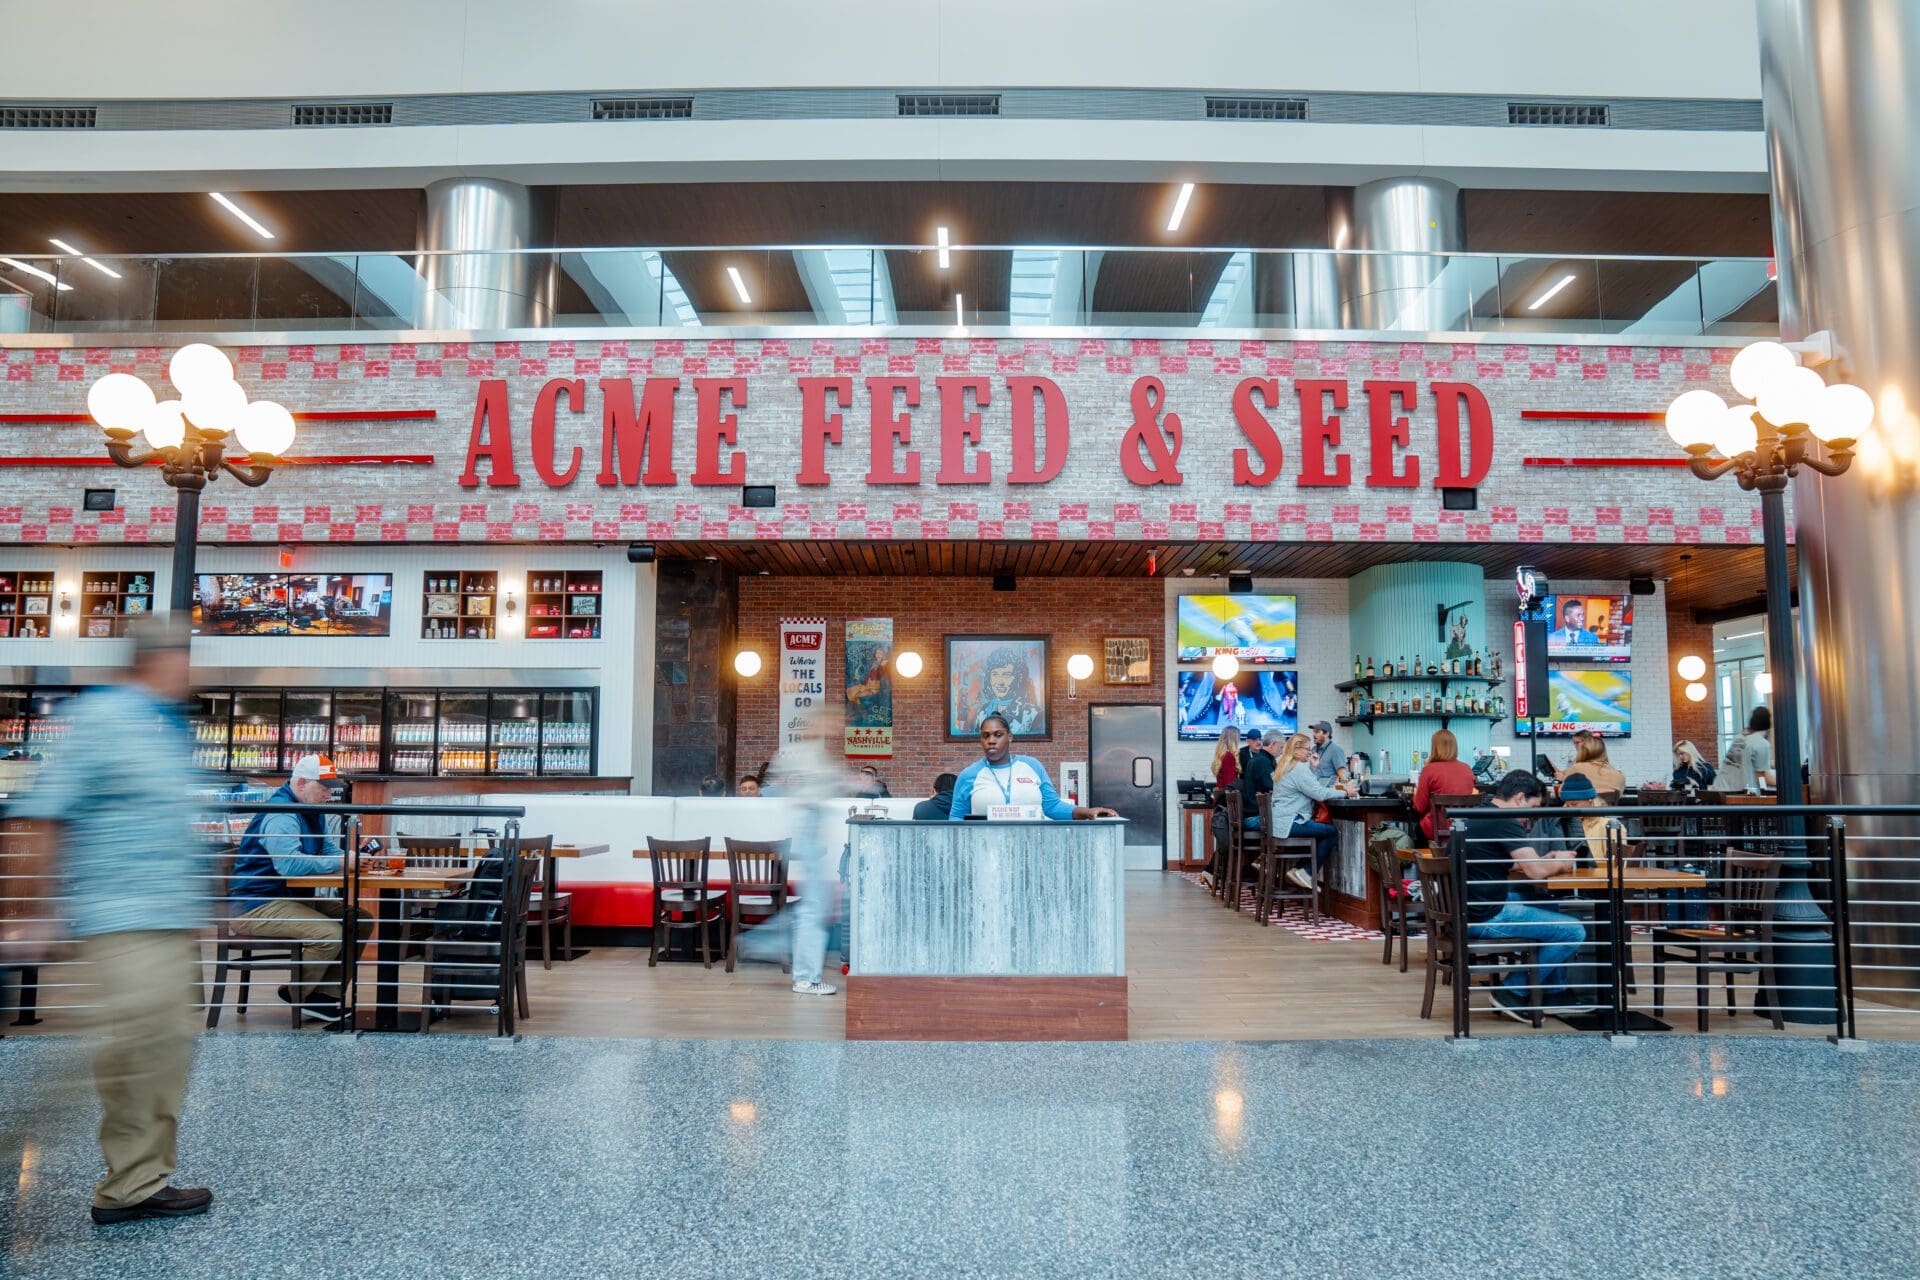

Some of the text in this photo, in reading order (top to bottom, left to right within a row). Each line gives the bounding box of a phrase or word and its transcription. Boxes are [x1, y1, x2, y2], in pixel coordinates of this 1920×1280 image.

[458, 375, 1494, 488] ACME FEED & SEED
[789, 634, 817, 645] ACME
[1215, 647, 1239, 655] KING
[789, 656, 817, 665] Where
[792, 669, 816, 679] THE
[783, 682, 823, 693] LOCALS
[795, 697, 812, 708] GO
[1551, 722, 1576, 730] KING
[847, 736, 891, 745] NASHVILLE
